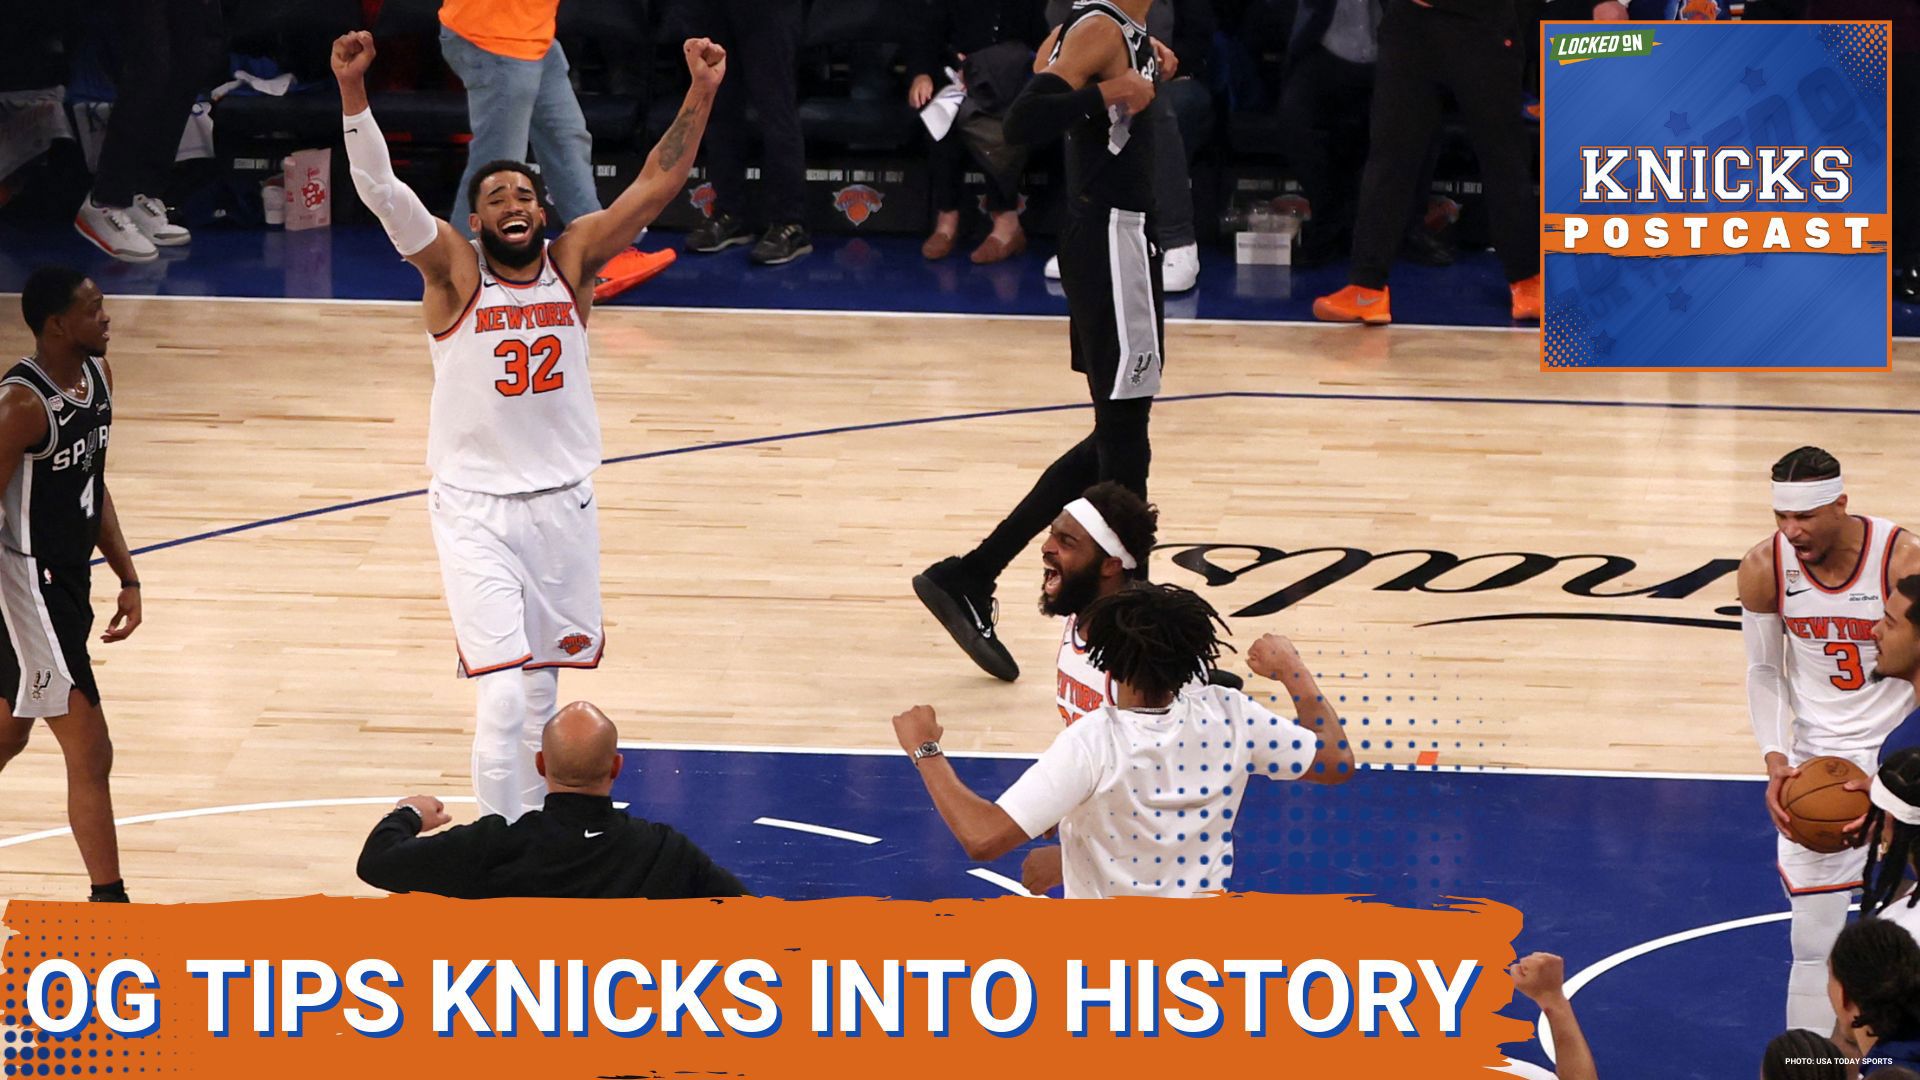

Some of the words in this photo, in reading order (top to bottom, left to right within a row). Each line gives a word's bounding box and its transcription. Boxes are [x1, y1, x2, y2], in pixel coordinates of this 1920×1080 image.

[475, 305, 522, 333] NEW
[521, 302, 574, 330] YORK
[494, 334, 564, 397] 32
[52, 424, 108, 472] SPUR
[80, 473, 95, 519] 4
[1150, 543, 1743, 629] nals
[1831, 616, 1881, 641] YOR
[1823, 641, 1866, 691] 3
